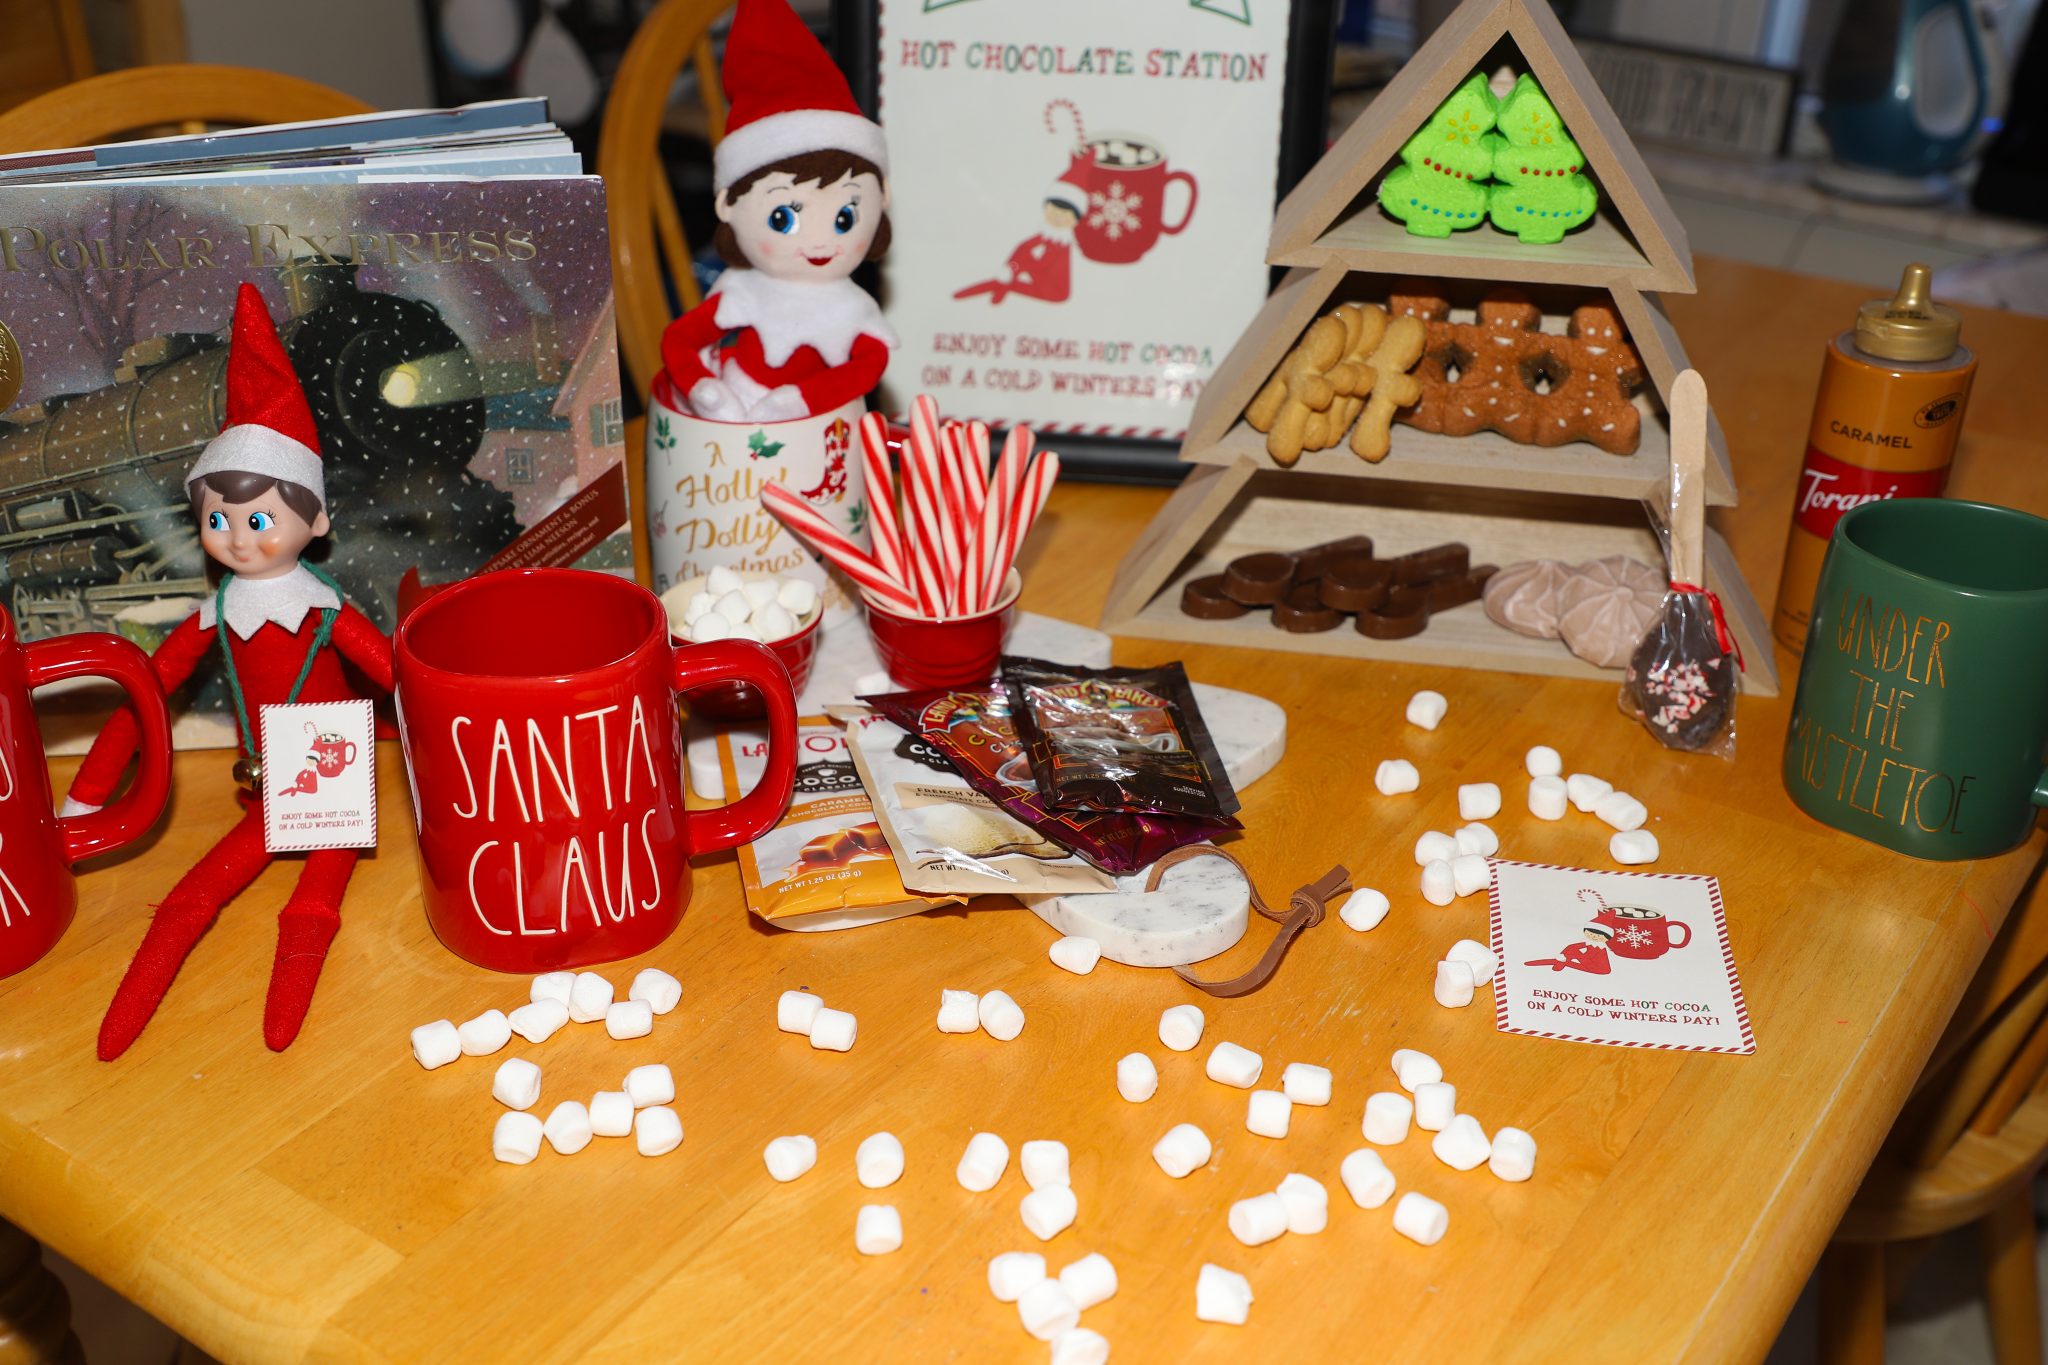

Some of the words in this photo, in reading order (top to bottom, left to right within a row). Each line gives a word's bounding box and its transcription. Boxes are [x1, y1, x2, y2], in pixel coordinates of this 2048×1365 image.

[900, 39, 956, 69] HOT
[965, 42, 1133, 76] CHOCOLATE
[1144, 48, 1268, 82] STATION
[0, 226, 222, 273] POLAR
[240, 224, 537, 268] EXPRESS
[933, 333, 1006, 357] ENJOY
[1015, 335, 1080, 360] SOME
[1089, 340, 1133, 363] HOT
[1140, 343, 1213, 366] COCOA
[922, 365, 951, 388] ON
[961, 368, 976, 388] A
[984, 367, 1041, 391] COLD
[1050, 371, 1156, 397] WINTERS
[1830, 420, 1912, 449] CARAMEL
[704, 441, 726, 468] A
[517, 516, 563, 552] ORNAMENT
[570, 489, 599, 513] BONUS
[676, 514, 783, 556] Dolly
[524, 542, 544, 559] LIAM
[544, 518, 578, 544] NEESON
[675, 548, 804, 582] Chtmas
[1838, 586, 1951, 689] UNDER
[1850, 669, 1914, 752] THE
[451, 695, 657, 823] SANTA
[805, 736, 837, 752] O
[810, 797, 869, 809] CARAMEL
[917, 787, 963, 797] FRENCH
[281, 812, 302, 820] ENJOY
[315, 820, 345, 828] WINTERS
[347, 819, 364, 827] DAY!
[792, 805, 846, 817] CHOCOLATE
[468, 808, 661, 935] CLAUS
[779, 883, 793, 894] NET
[795, 880, 805, 888] WT
[808, 876, 824, 885] 1.25
[826, 873, 836, 881] OZ
[837, 871, 850, 880] (35
[853, 870, 862, 878] g)
[1527, 1001, 1546, 1010] ON
[1552, 1004, 1563, 1013] A
[1567, 1006, 1603, 1018] COLD
[1609, 1010, 1678, 1024] WINTERS
[1683, 1015, 1720, 1026] DAY!
[1533, 989, 1579, 1003] ENJOY
[1584, 995, 1625, 1007] SOME
[1631, 1000, 1659, 1009] HOT
[1664, 1002, 1711, 1013] COCOA
